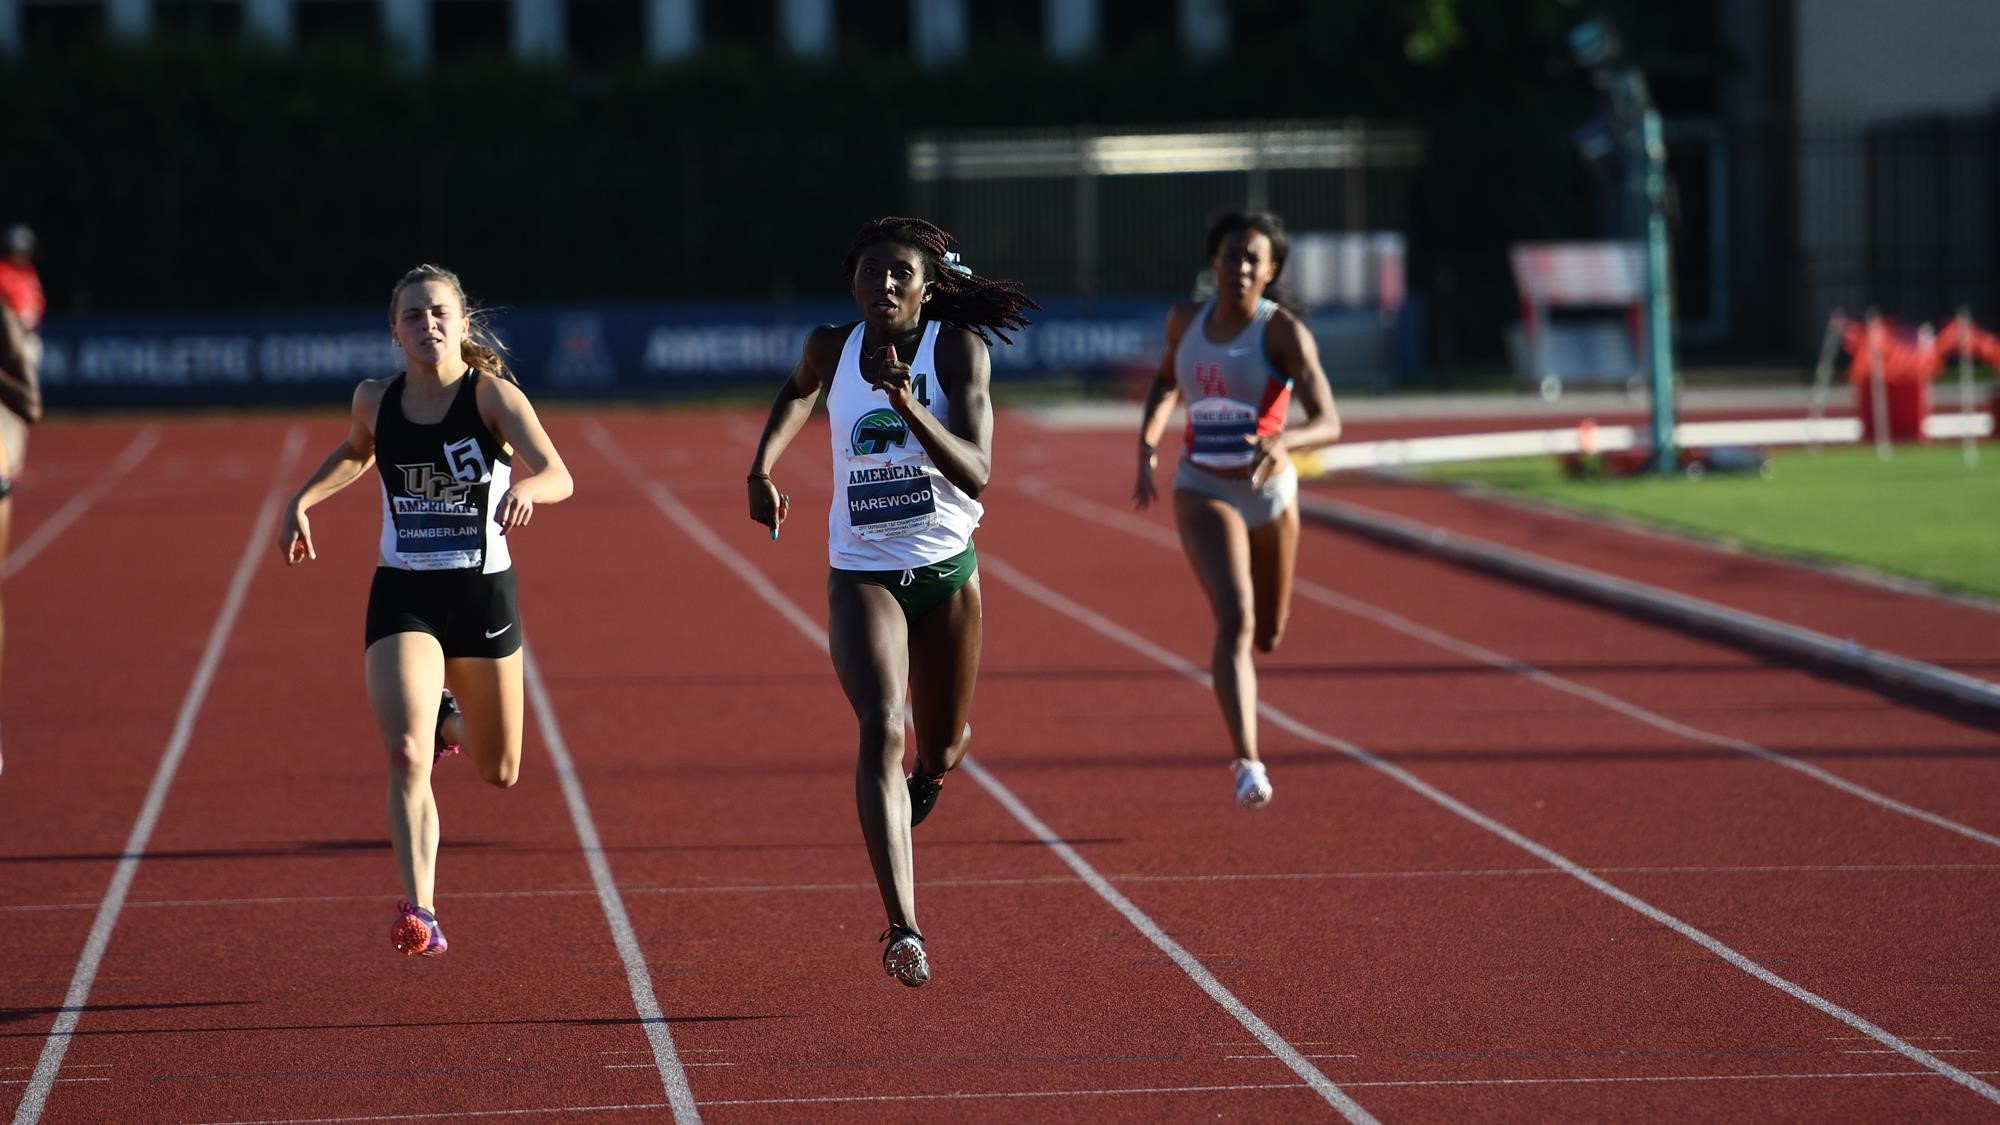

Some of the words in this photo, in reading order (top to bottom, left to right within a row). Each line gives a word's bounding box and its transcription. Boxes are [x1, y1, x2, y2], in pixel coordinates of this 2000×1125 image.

[78, 336, 253, 384] ATHLETIC
[912, 373, 930, 408] 4
[451, 444, 482, 482] 5
[849, 465, 924, 485] AMERICAN
[398, 464, 472, 504] UCF
[851, 490, 931, 511] HAREWOOD
[399, 526, 478, 538] CHAMBERLAIN
